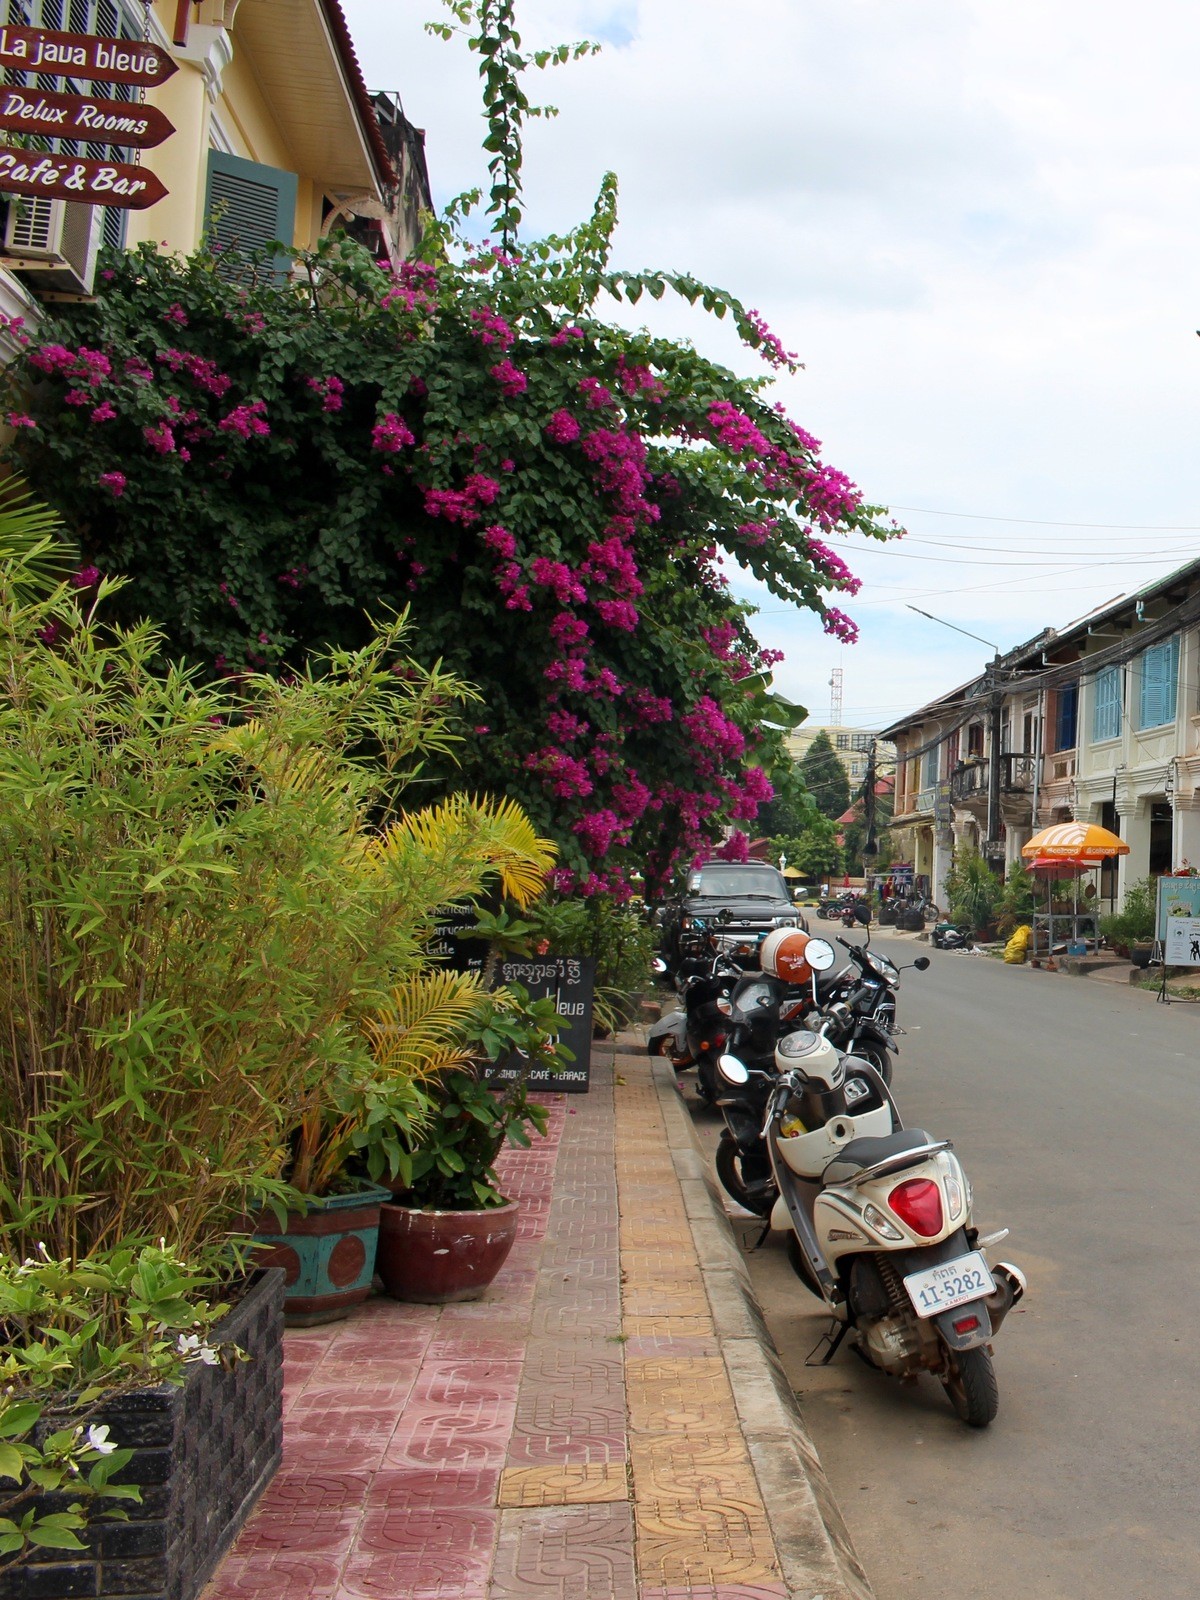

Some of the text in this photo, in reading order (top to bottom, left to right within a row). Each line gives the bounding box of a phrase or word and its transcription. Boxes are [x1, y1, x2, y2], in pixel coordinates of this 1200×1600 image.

[0, 29, 27, 58] La
[95, 43, 159, 75] bleue
[4, 94, 149, 135] Delux Rooms
[0, 154, 147, 196] Café & Bar
[944, 1294, 970, 1307] KAMPOT
